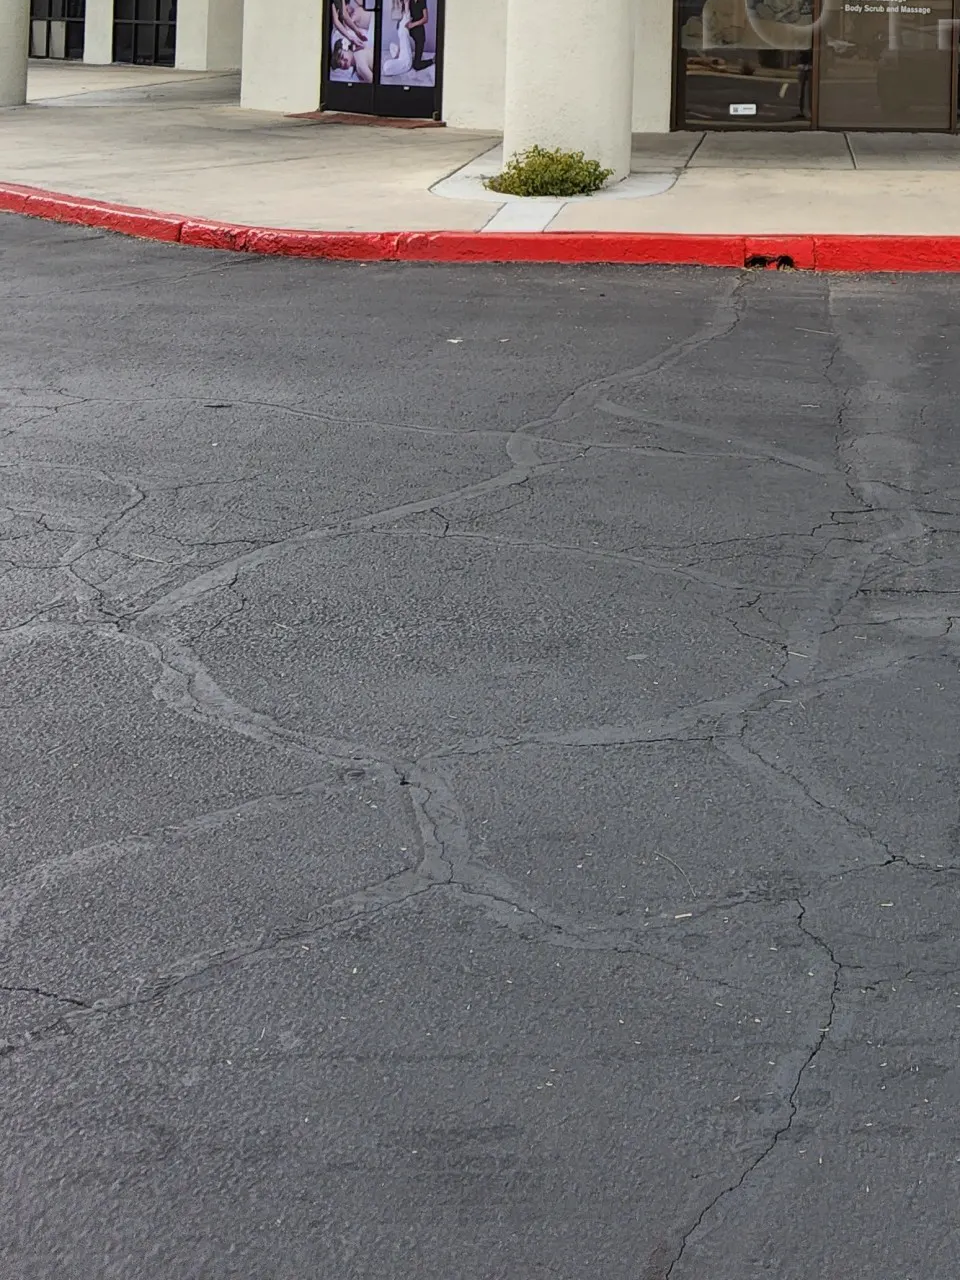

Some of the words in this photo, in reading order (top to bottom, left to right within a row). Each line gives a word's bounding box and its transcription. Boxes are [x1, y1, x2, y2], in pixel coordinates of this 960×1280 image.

[845, 4, 863, 13] Body
[864, 4, 885, 12] Scrub
[900, 5, 931, 15] Massage
